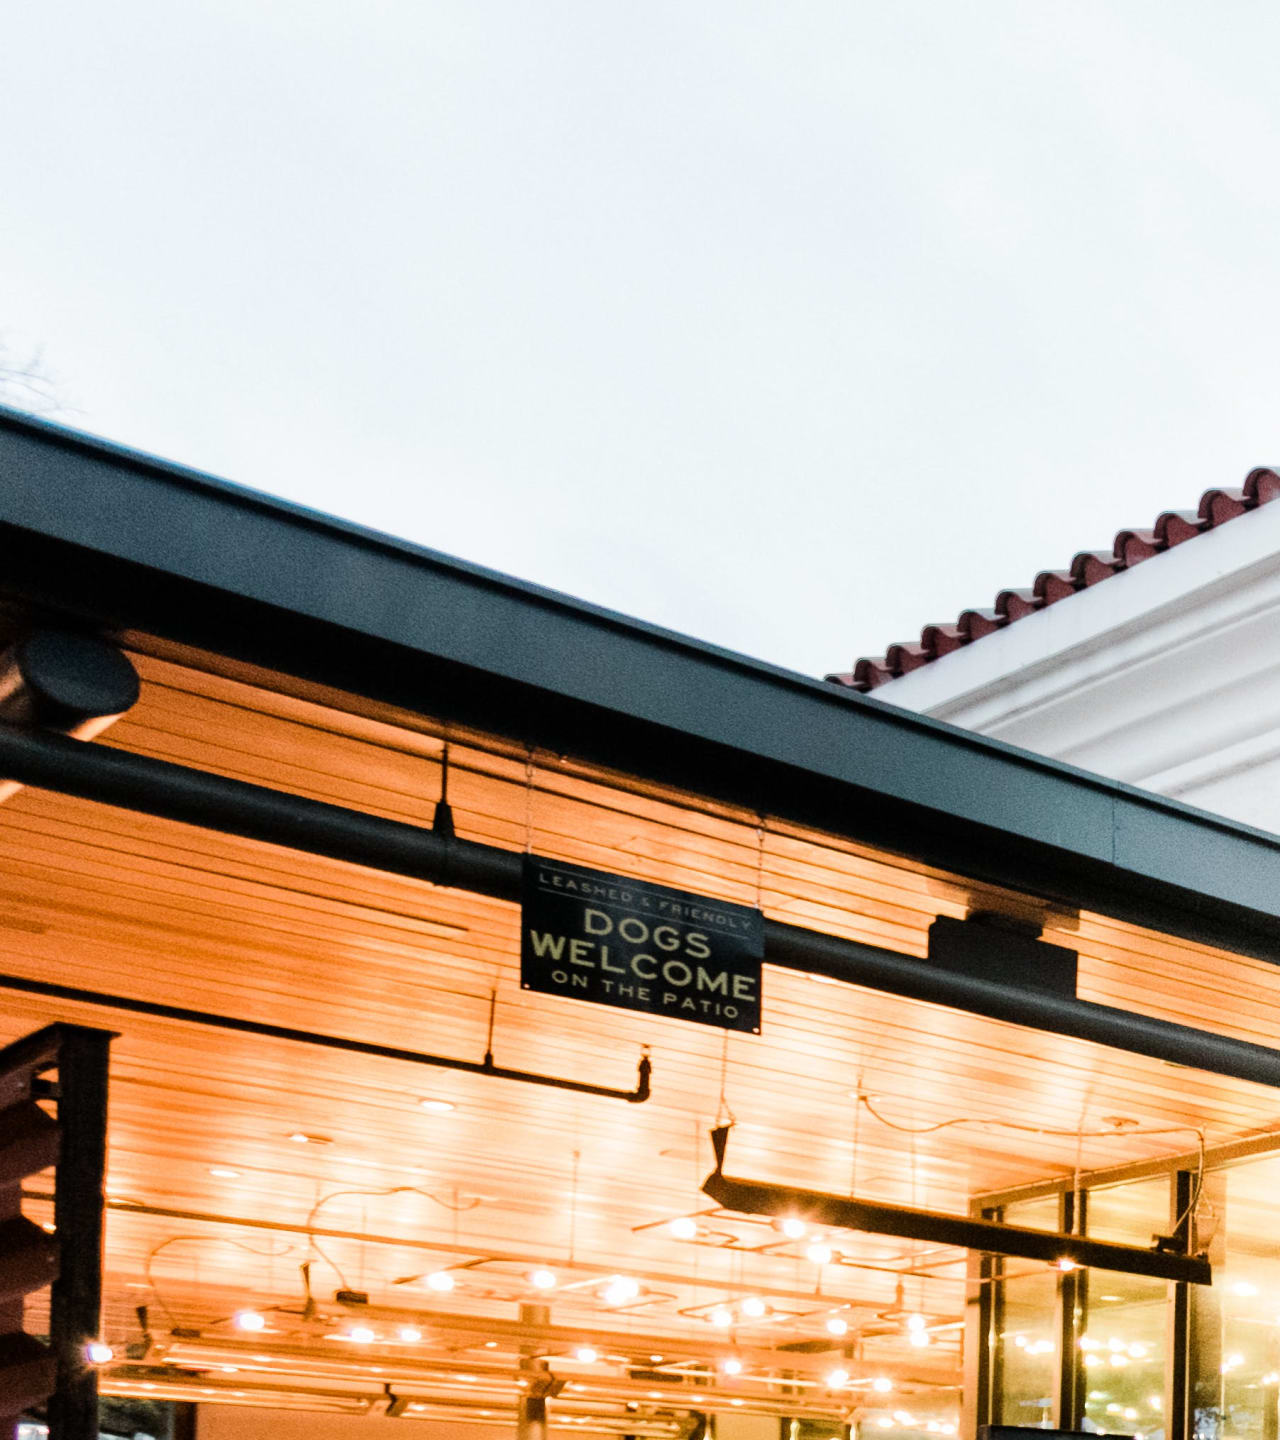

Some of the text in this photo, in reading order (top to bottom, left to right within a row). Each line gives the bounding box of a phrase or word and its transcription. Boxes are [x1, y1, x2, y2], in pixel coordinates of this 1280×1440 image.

[539, 873, 633, 902] LEASHED
[659, 901, 752, 930] FRIENDLY
[584, 908, 711, 959] DOGS
[530, 929, 756, 1002] WELCOME
[551, 970, 739, 1019] ON THE PATIO
